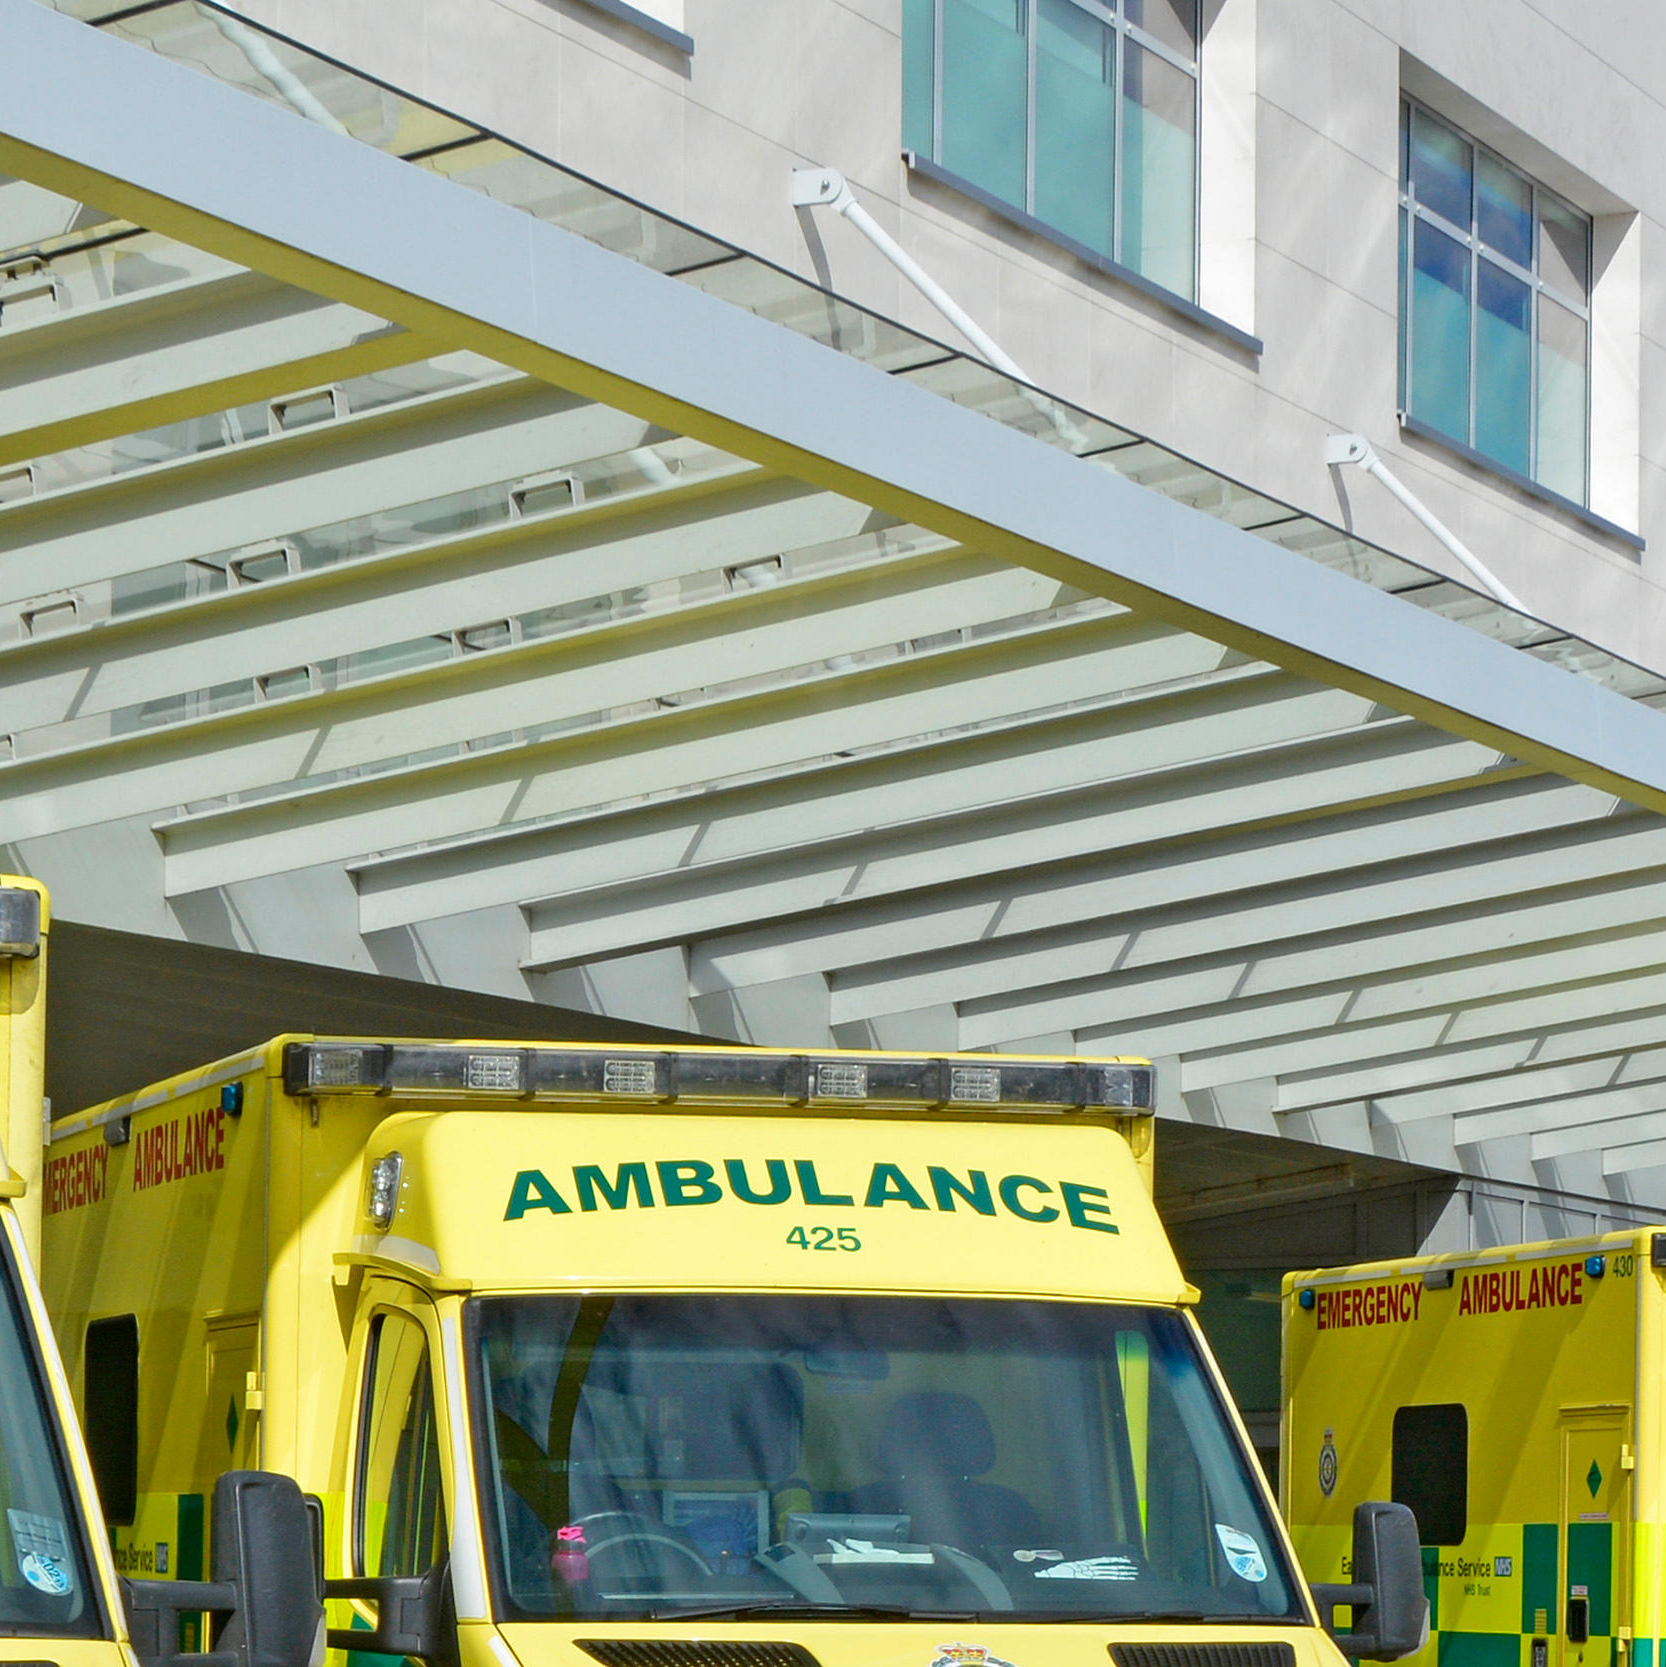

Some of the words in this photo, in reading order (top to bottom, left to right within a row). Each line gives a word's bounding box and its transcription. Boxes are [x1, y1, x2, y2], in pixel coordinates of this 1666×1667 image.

[42, 1146, 109, 1217] MERGENCY
[133, 1107, 225, 1192] AMBULANCE
[503, 1159, 1120, 1235] AMBULANCE
[786, 1226, 862, 1252] 425
[1613, 1255, 1633, 1278] 430
[1317, 1281, 1423, 1330] EMERGENCY
[1458, 1262, 1583, 1316] AMBULANCE
[1457, 1556, 1491, 1577] Service
[1494, 1556, 1512, 1576] NHS
